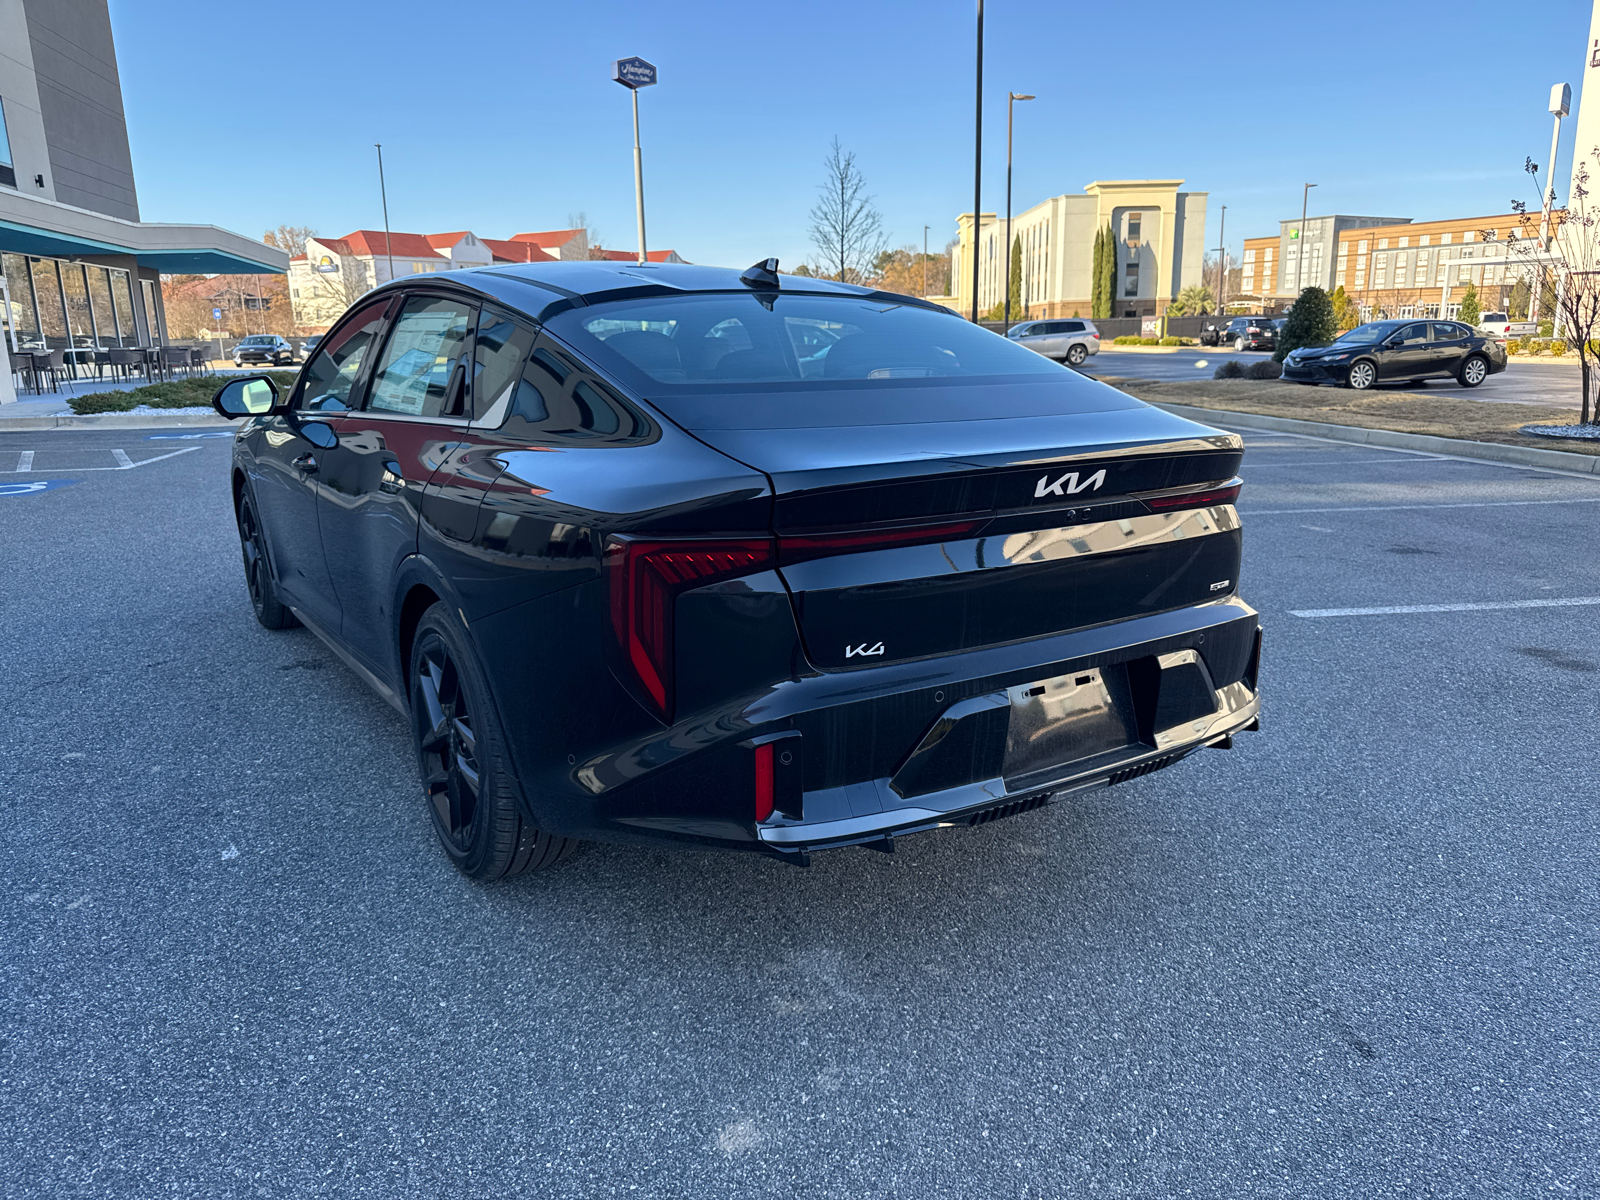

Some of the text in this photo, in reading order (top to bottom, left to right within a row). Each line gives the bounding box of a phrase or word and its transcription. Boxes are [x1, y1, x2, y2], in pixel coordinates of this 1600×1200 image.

[621, 63, 653, 77] Hampton
[1034, 469, 1107, 498] KIA
[845, 641, 885, 658] K4
